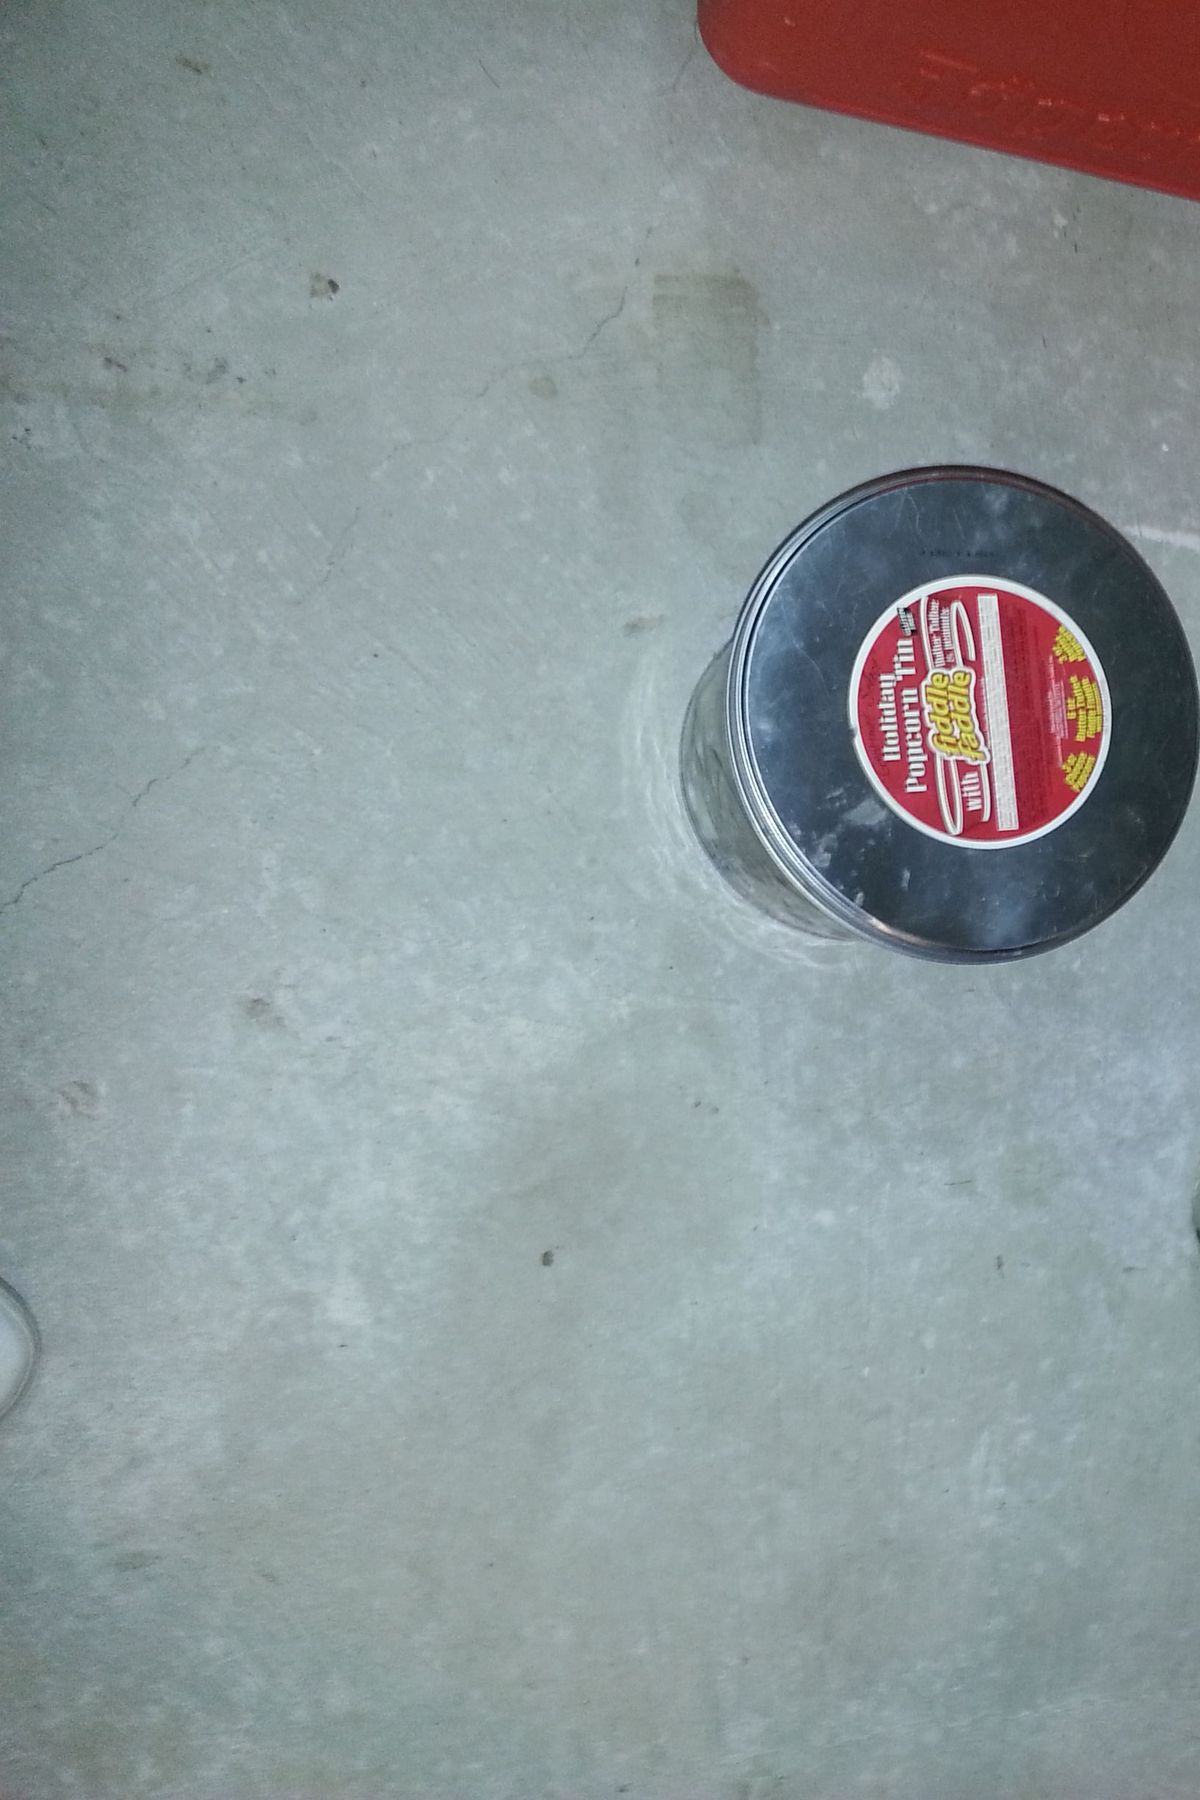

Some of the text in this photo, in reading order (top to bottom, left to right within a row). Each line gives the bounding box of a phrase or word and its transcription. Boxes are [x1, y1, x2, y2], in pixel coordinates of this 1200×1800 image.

[880, 674, 900, 761] Holiday
[893, 638, 928, 793] Popcorn Tin
[926, 671, 957, 754] fiddle
[948, 670, 986, 760] faddle
[962, 771, 982, 811] with
